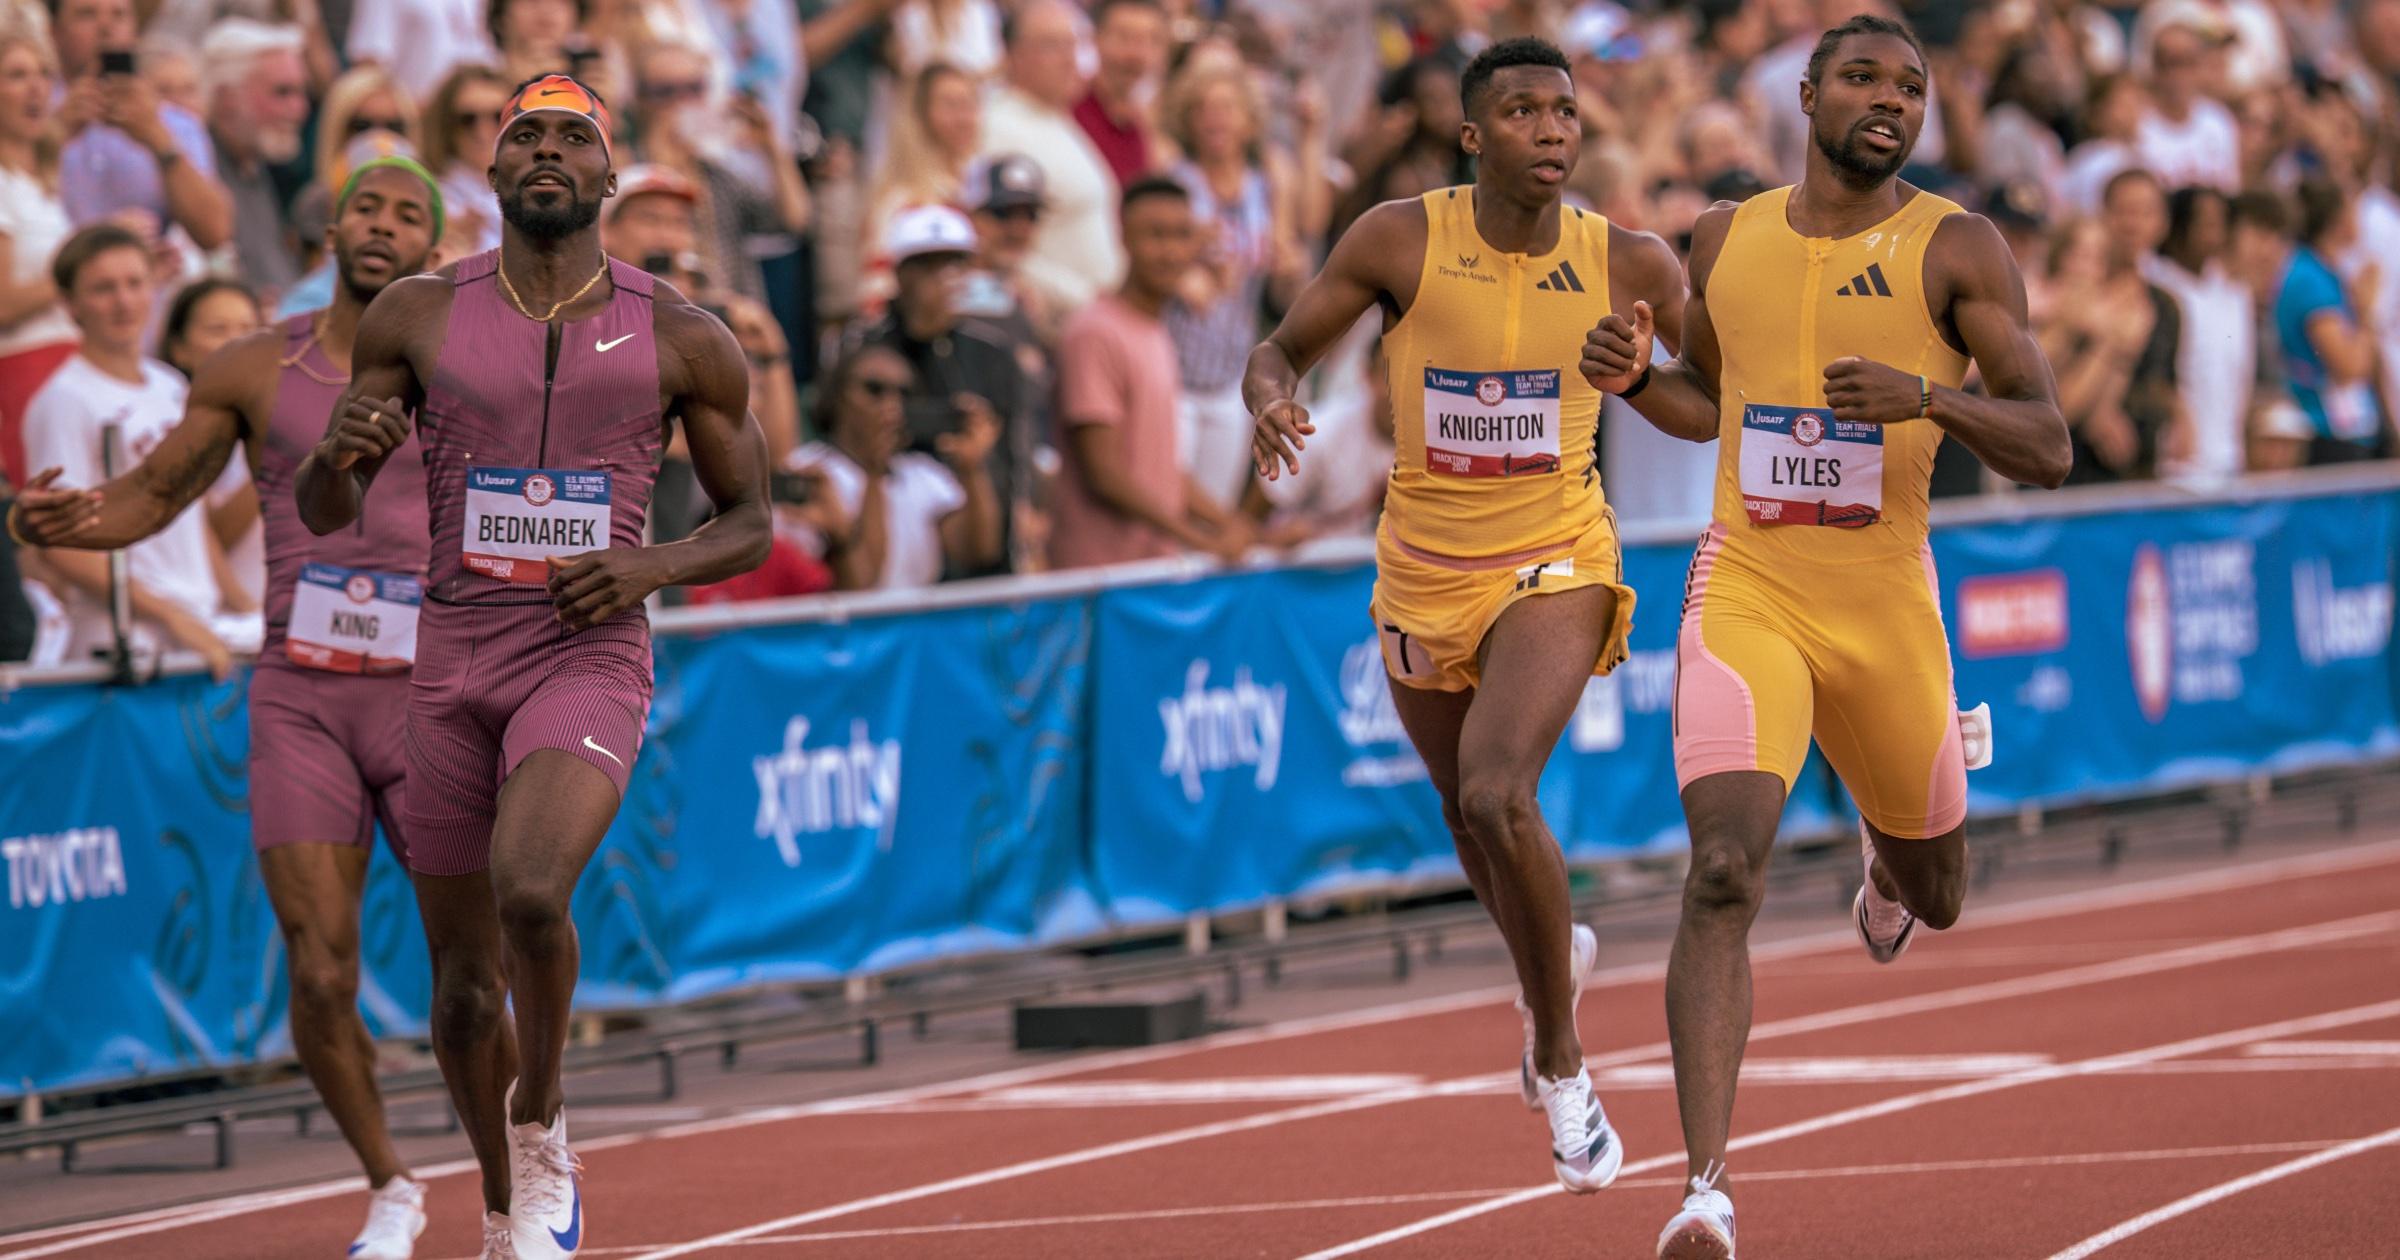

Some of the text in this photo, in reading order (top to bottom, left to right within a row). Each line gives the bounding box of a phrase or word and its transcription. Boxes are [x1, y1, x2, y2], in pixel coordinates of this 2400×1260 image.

[1470, 272, 1497, 283] Angels
[1516, 382, 1532, 390] TEAM
[1760, 415, 1785, 424] USATF
[1439, 413, 1544, 441] KNIGHTON
[1835, 423, 1877, 432] TEAM TRIALS
[1432, 452, 1471, 465] TRACKTOWN
[1452, 463, 1470, 472] 2024
[1771, 455, 1841, 487] LYLES
[565, 483, 582, 492] TEAM
[1744, 500, 1782, 512] RACKTOWN
[1760, 510, 1779, 520] 2024
[479, 514, 596, 547] BEDNAREK
[469, 557, 514, 569] TRACKTOWN
[492, 567, 512, 577] 2024
[331, 610, 380, 641] KING
[1384, 623, 1412, 675] 7
[1158, 658, 1287, 803] xfinity
[752, 714, 901, 868] xfinity
[1, 825, 127, 909] TOYOTA
